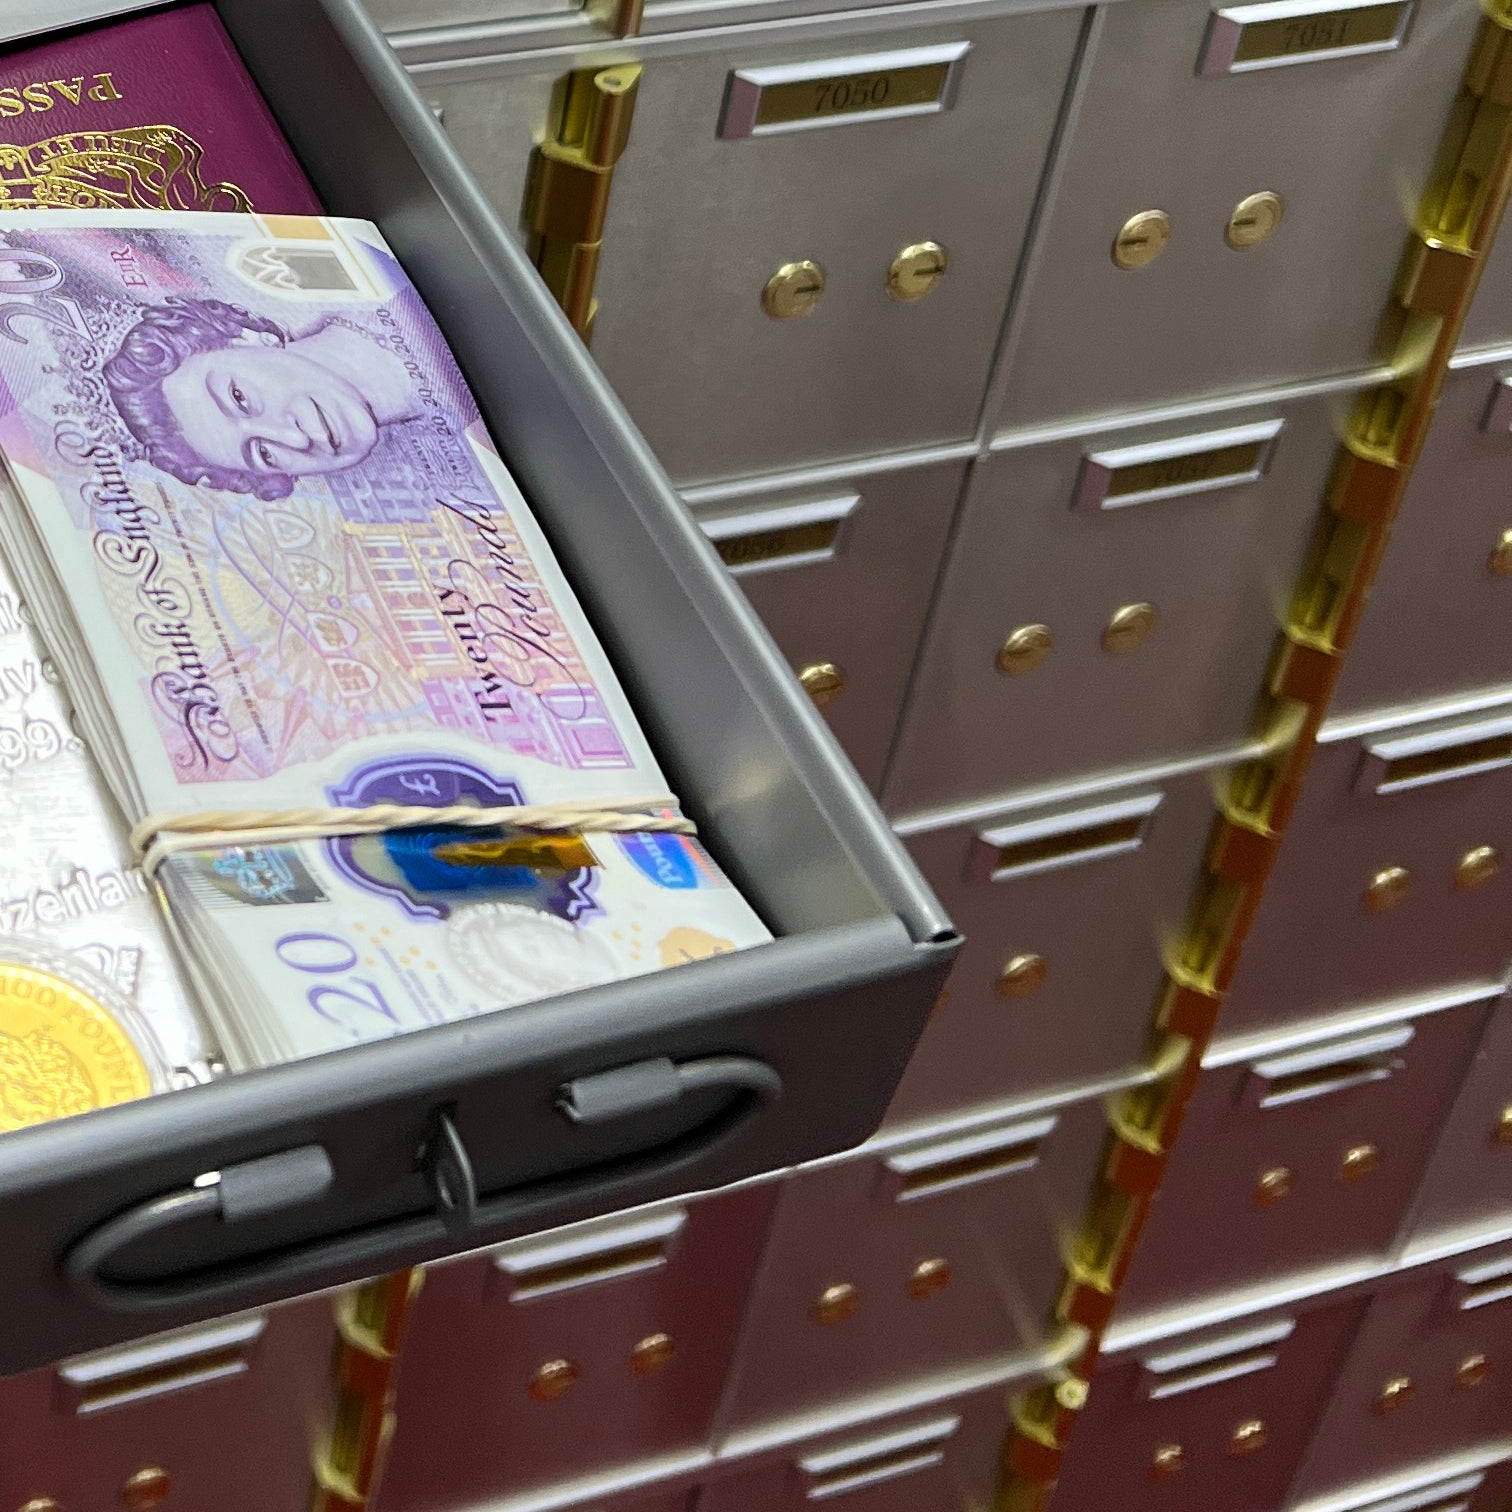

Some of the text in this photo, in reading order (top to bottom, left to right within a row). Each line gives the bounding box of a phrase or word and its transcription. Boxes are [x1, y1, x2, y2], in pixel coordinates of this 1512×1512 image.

[815, 77, 890, 113] 7050
[53, 420, 161, 584] England
[433, 582, 521, 723] Twenty
[435, 490, 587, 721] Pounds
[134, 614, 240, 769] Bank
[274, 932, 401, 1024] 20
